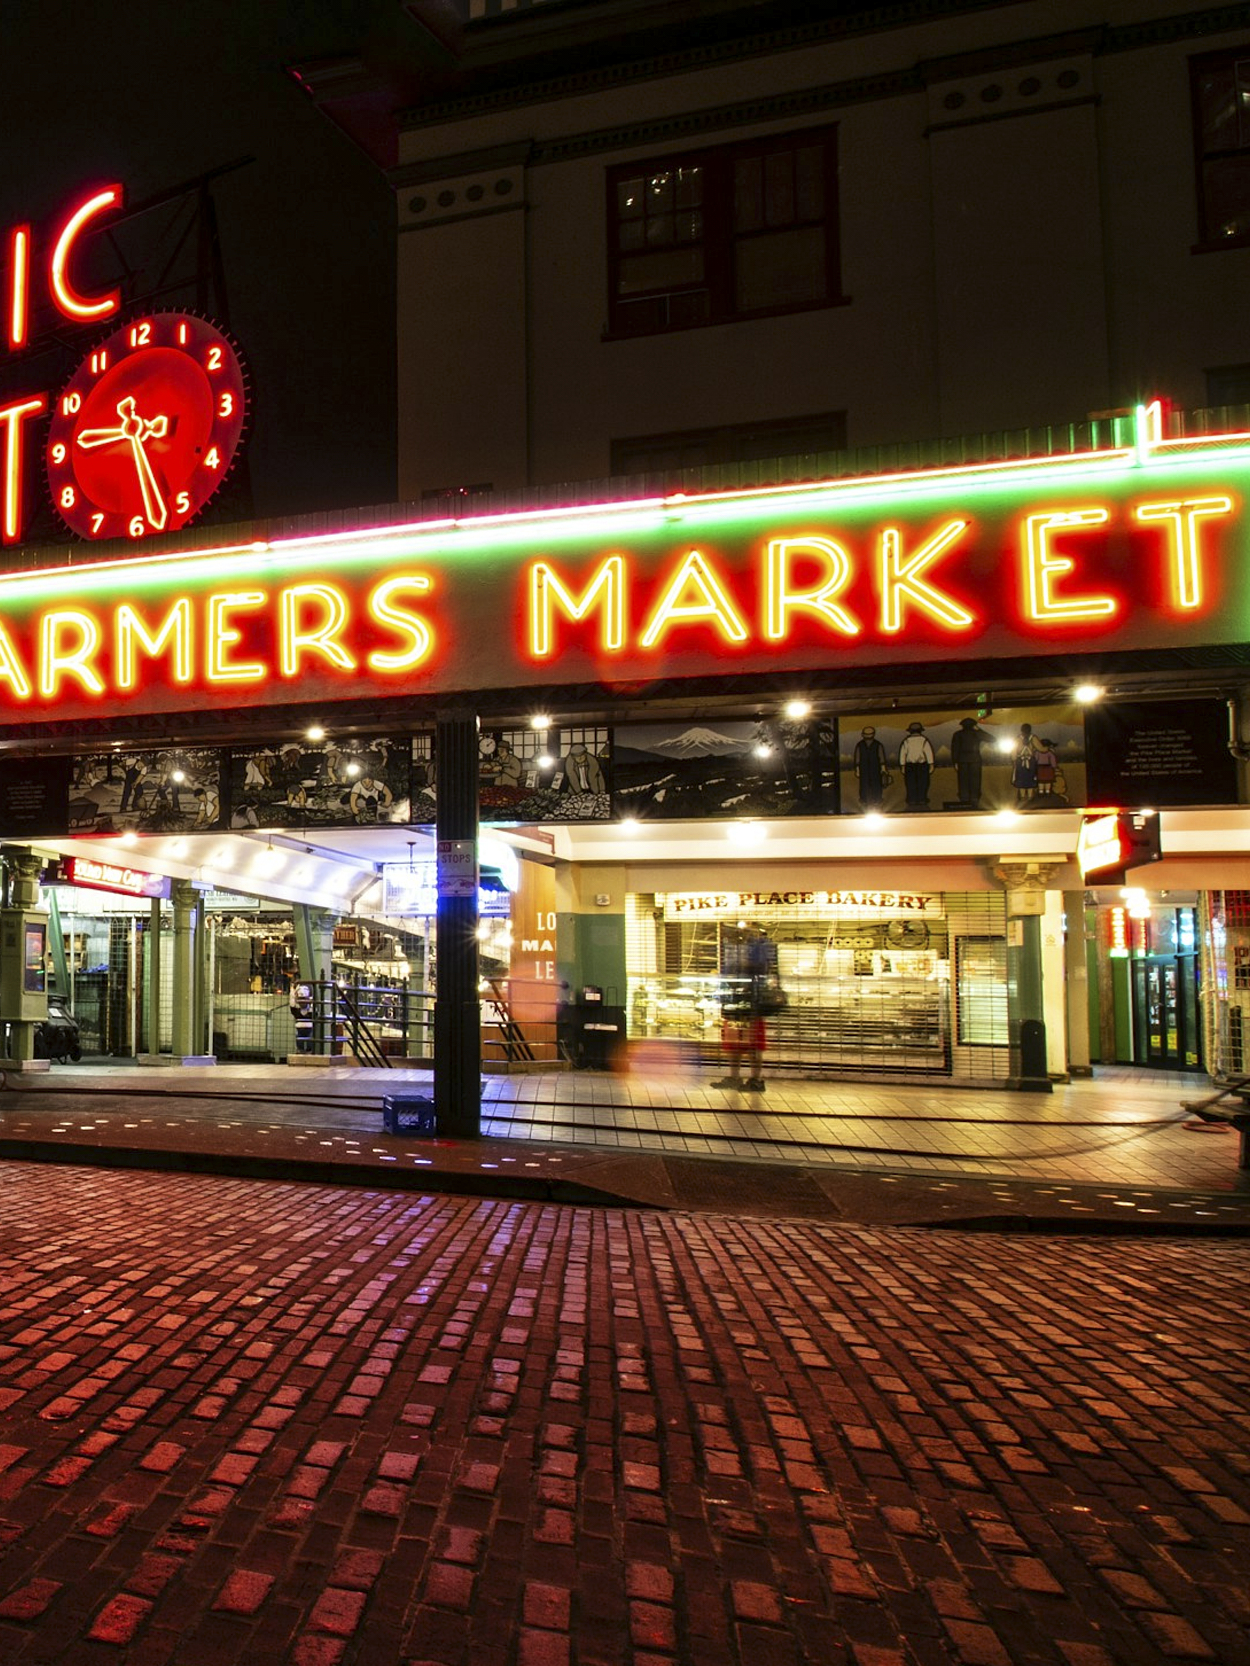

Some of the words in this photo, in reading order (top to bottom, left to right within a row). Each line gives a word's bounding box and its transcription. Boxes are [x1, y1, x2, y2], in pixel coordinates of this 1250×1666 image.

[130, 322, 151, 347] 12
[179, 323, 187, 345] 1
[91, 351, 107, 374] 11
[208, 347, 222, 370] 2
[62, 392, 81, 416] 10
[219, 392, 233, 417] 3
[52, 443, 66, 464] 9
[204, 447, 220, 469] 4
[61, 486, 75, 508] 8
[176, 491, 190, 514] 5
[91, 513, 104, 533] 7
[129, 515, 145, 537] 6
[531, 495, 1234, 656] MARKET
[439, 843, 450, 851] NO
[441, 854, 471, 864] STOPS
[673, 894, 729, 912] PIKE
[738, 891, 816, 907] PLACE
[825, 891, 934, 911] BAKERY
[522, 939, 557, 952] MA
